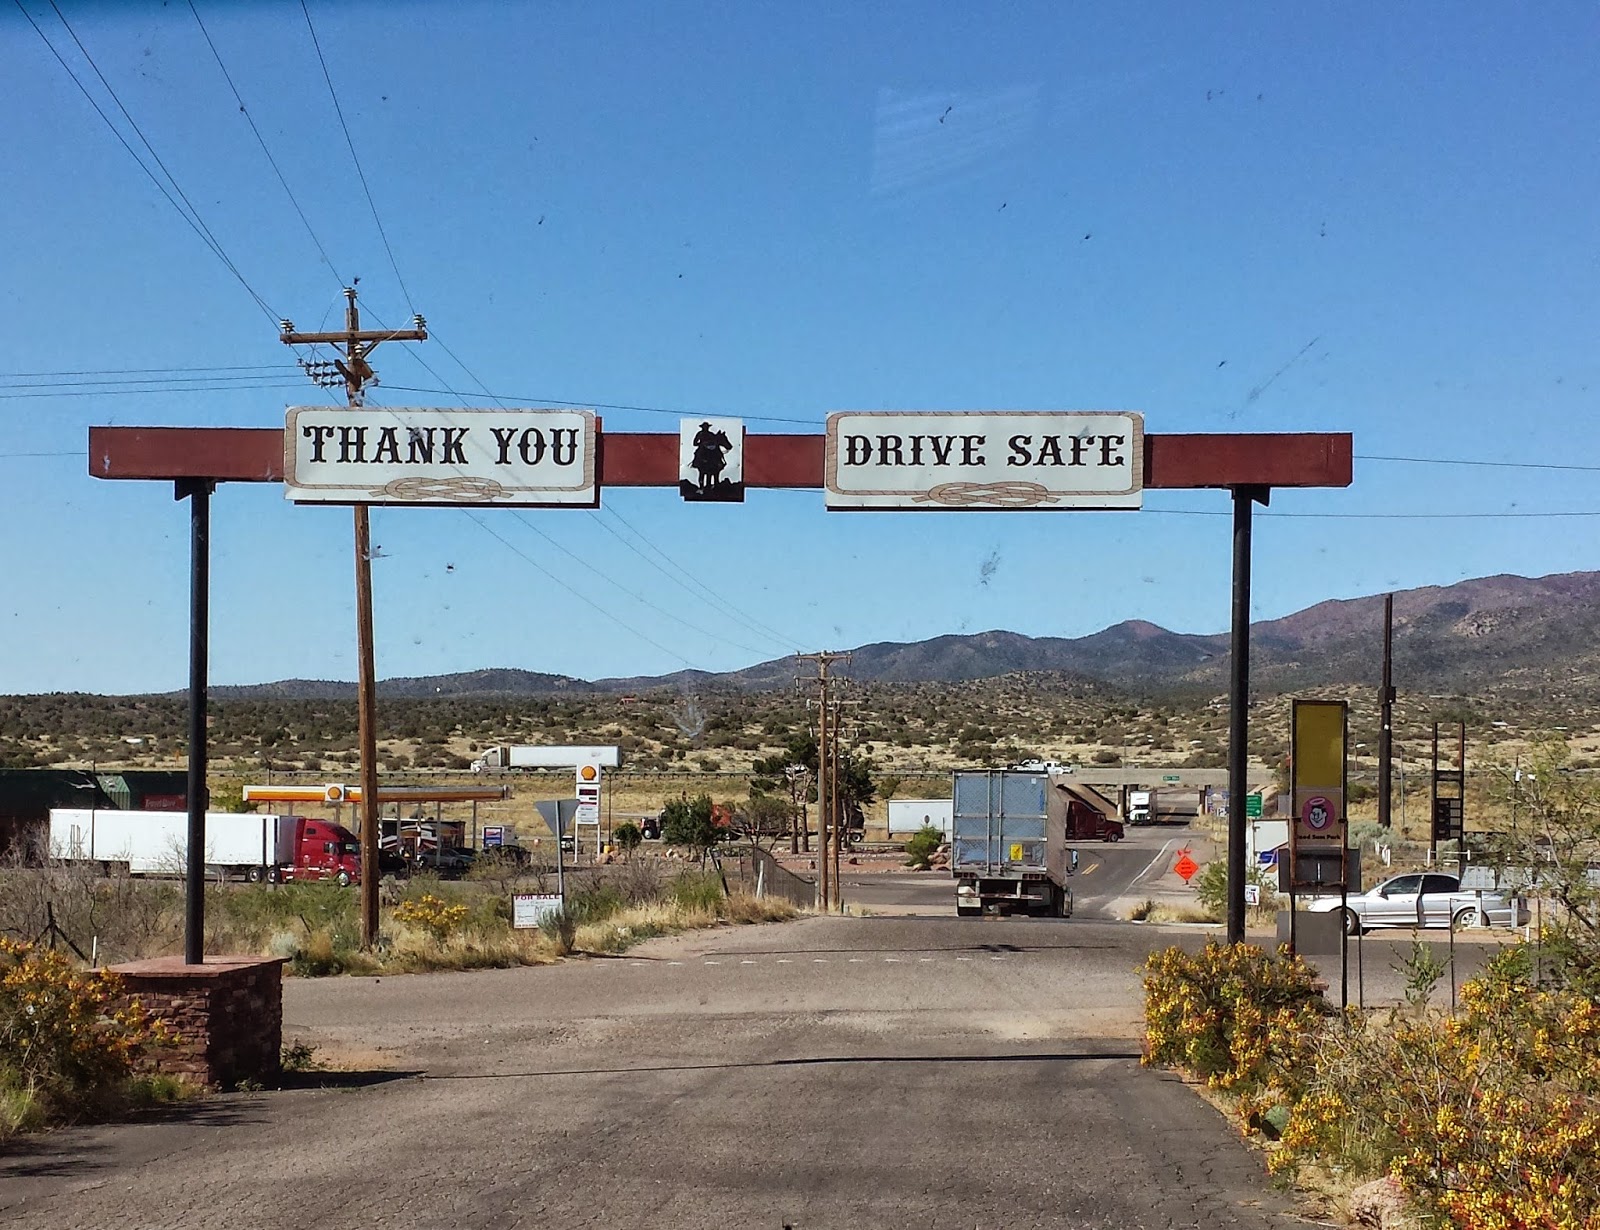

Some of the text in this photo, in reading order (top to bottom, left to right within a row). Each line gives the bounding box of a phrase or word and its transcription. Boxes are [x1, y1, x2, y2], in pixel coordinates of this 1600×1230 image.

[302, 425, 580, 466] THANK YOU
[843, 434, 1125, 467] DRIVE SAFE
